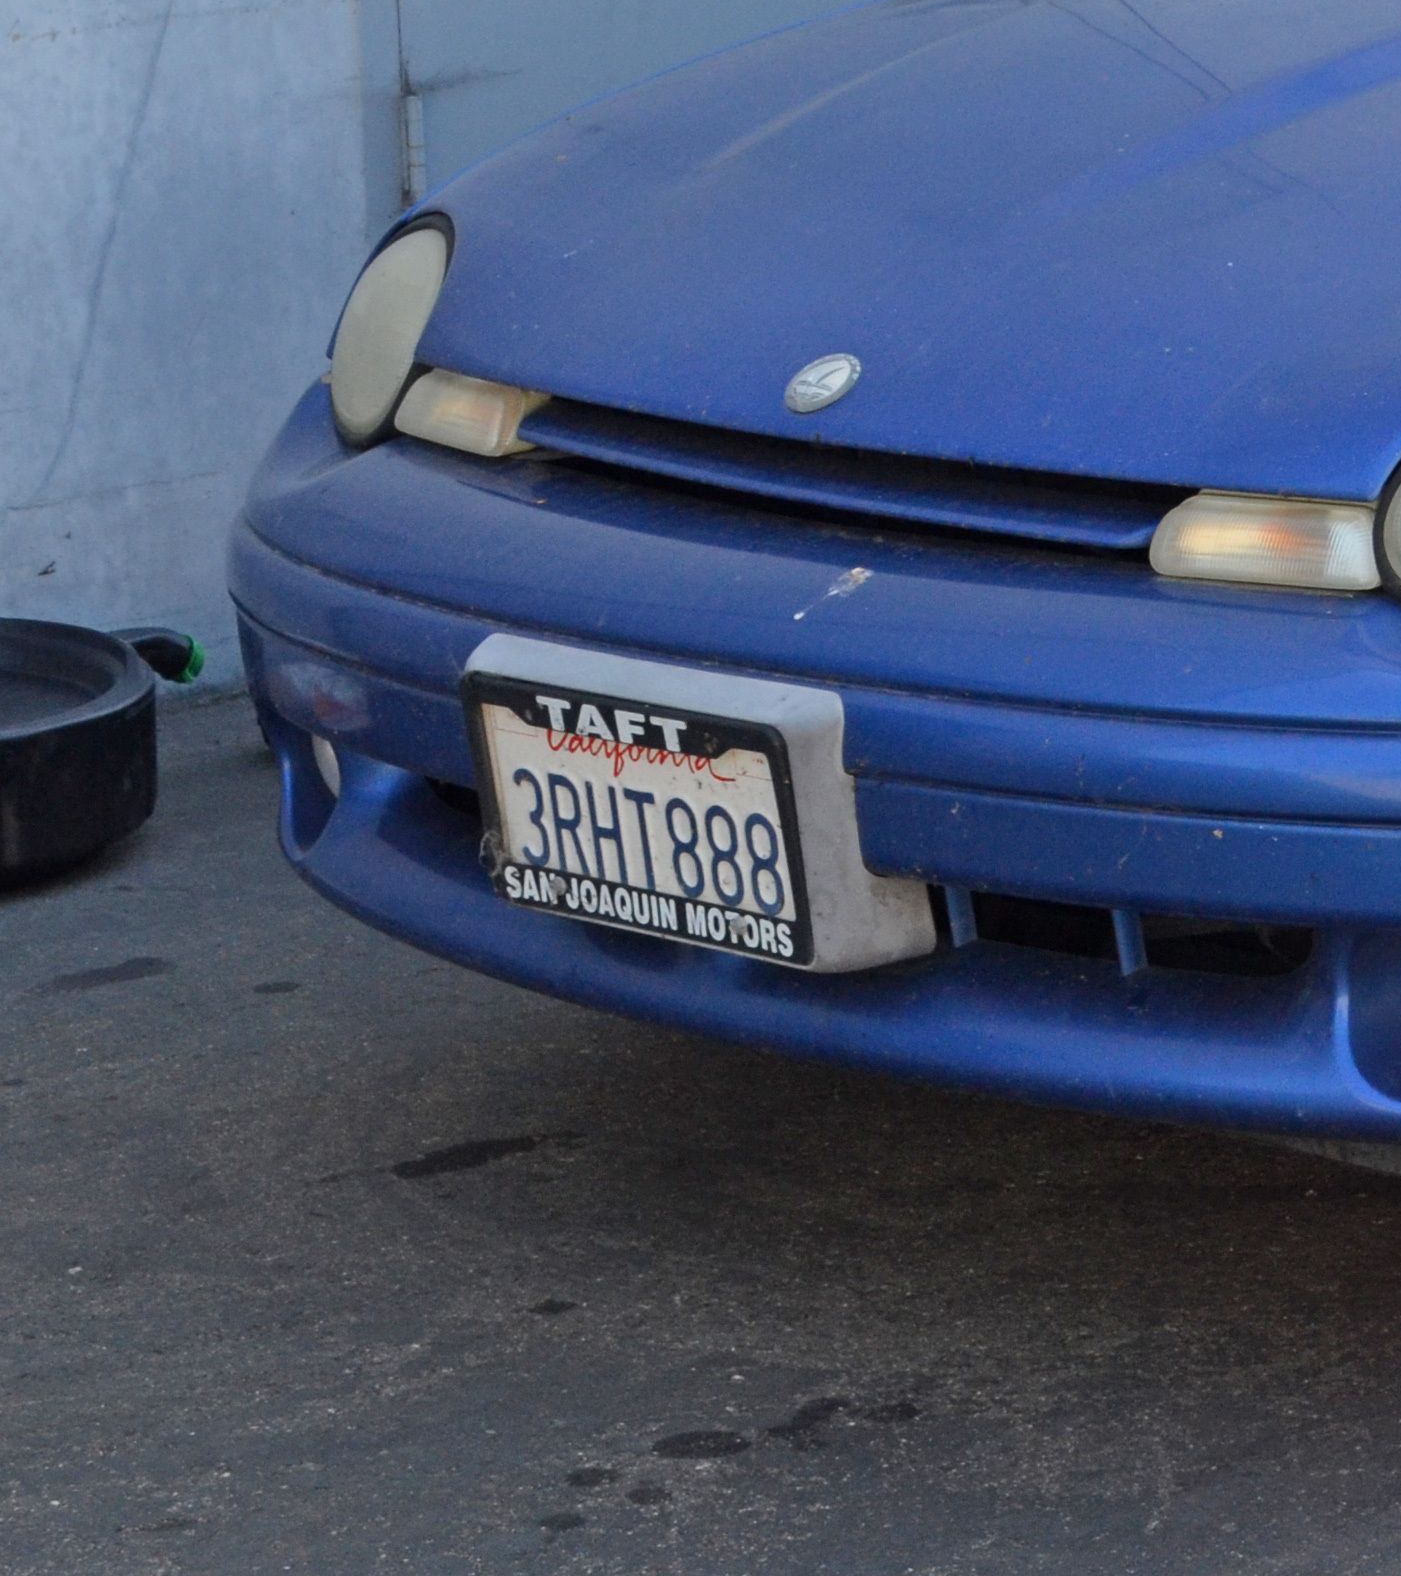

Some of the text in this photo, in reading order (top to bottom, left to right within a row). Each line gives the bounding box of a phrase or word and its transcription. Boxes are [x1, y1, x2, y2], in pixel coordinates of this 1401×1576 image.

[535, 695, 687, 753] TAFT
[512, 768, 785, 917] 3RHT888
[504, 865, 794, 958] SAN JOAQUIN MOTORS
